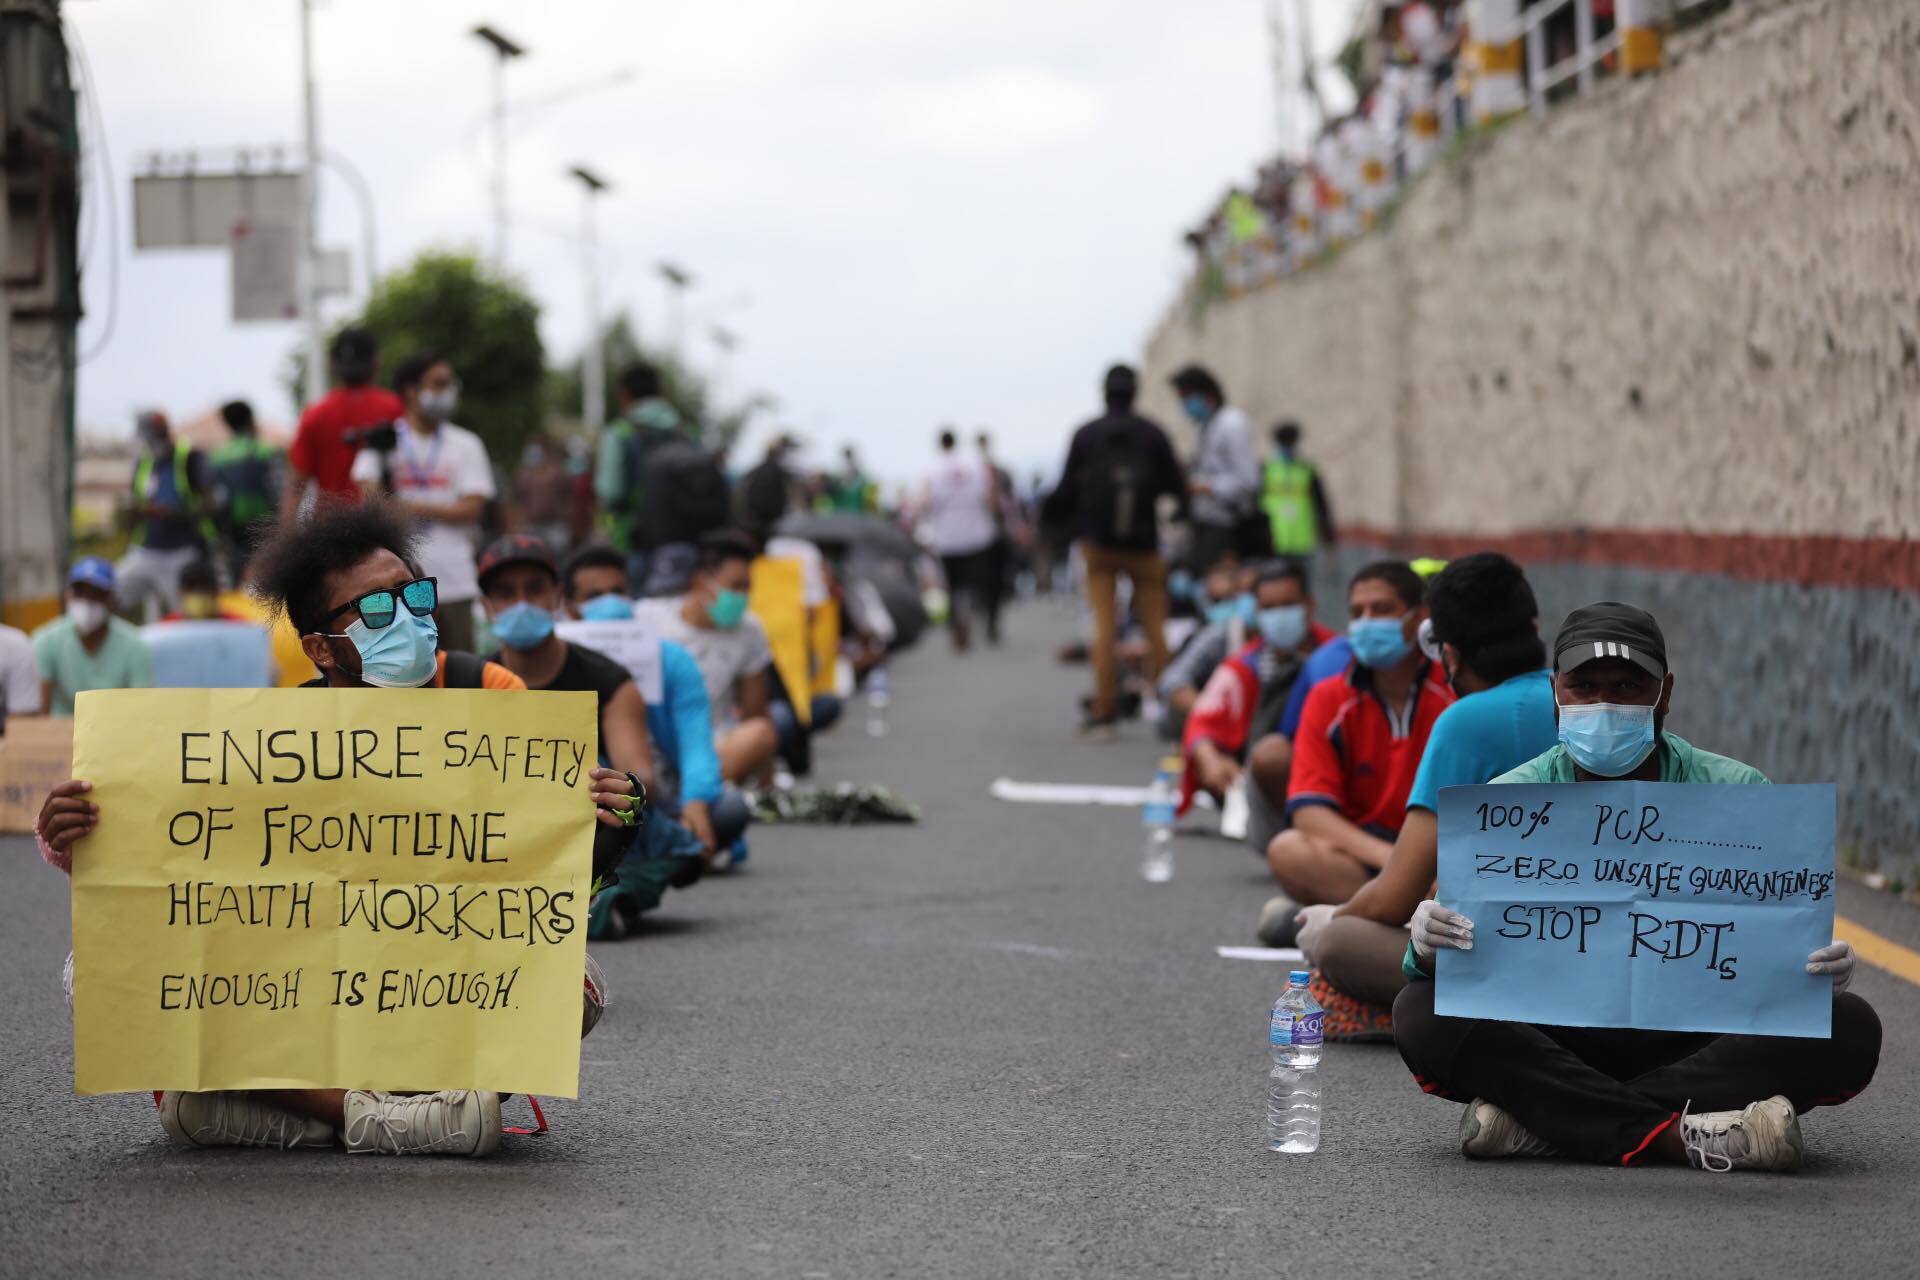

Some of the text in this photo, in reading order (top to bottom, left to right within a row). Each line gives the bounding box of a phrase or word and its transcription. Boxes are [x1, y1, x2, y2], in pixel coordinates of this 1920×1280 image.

[181, 726, 586, 788] ENSURE SAFETY
[168, 805, 508, 866] OF FRONTLINE
[1476, 802, 1554, 839] 100%
[1475, 854, 1579, 882] ZERO
[1593, 858, 1683, 898] UNSAFE
[168, 879, 574, 946] HEALTH WORKERS
[1496, 904, 1601, 953] STOP
[160, 967, 302, 1011] ENOUGH
[331, 970, 369, 1007] IS
